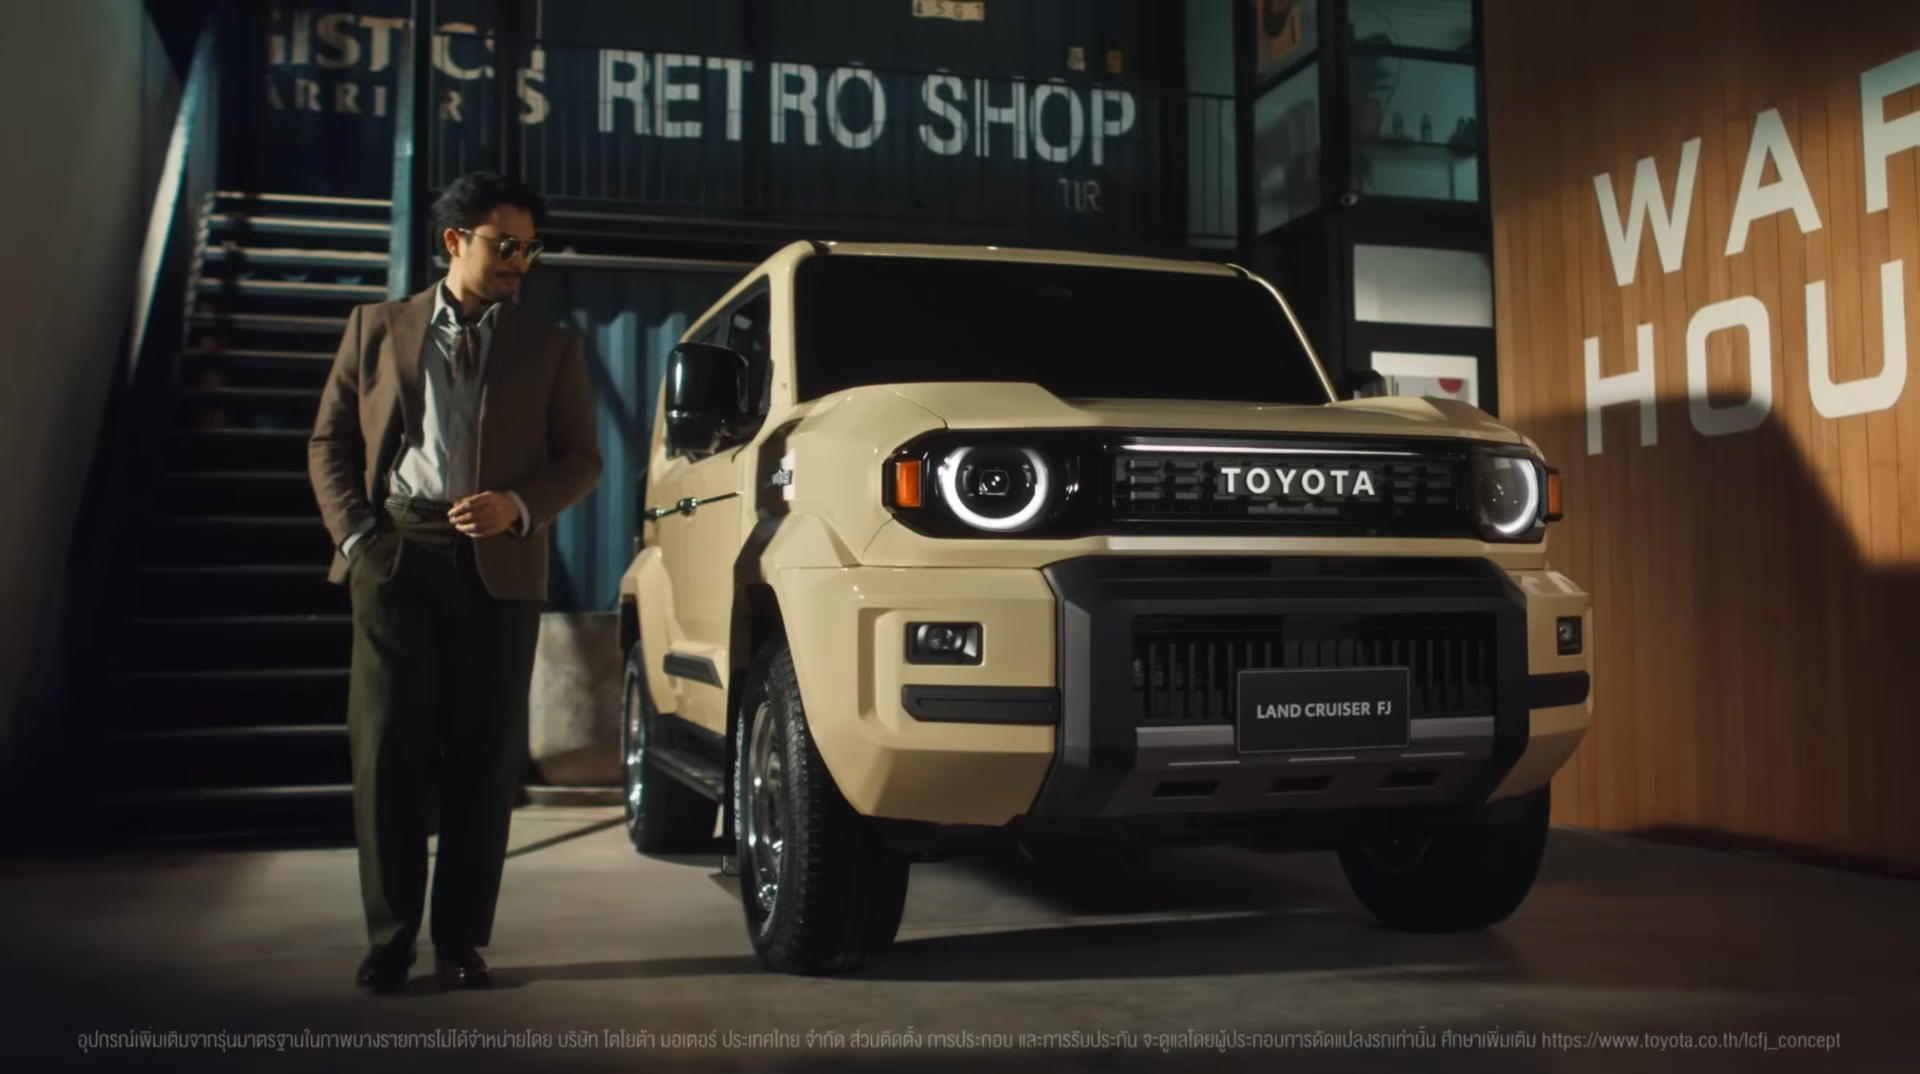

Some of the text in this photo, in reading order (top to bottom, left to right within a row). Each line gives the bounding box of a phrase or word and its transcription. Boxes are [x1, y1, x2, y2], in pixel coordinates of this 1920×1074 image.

[598, 48, 1136, 166] RETRO SHOP
[1583, 259, 1908, 455] HOU
[1221, 467, 1376, 496] TOYOTA
[1256, 700, 1392, 719] LAND CRUISER FJ
